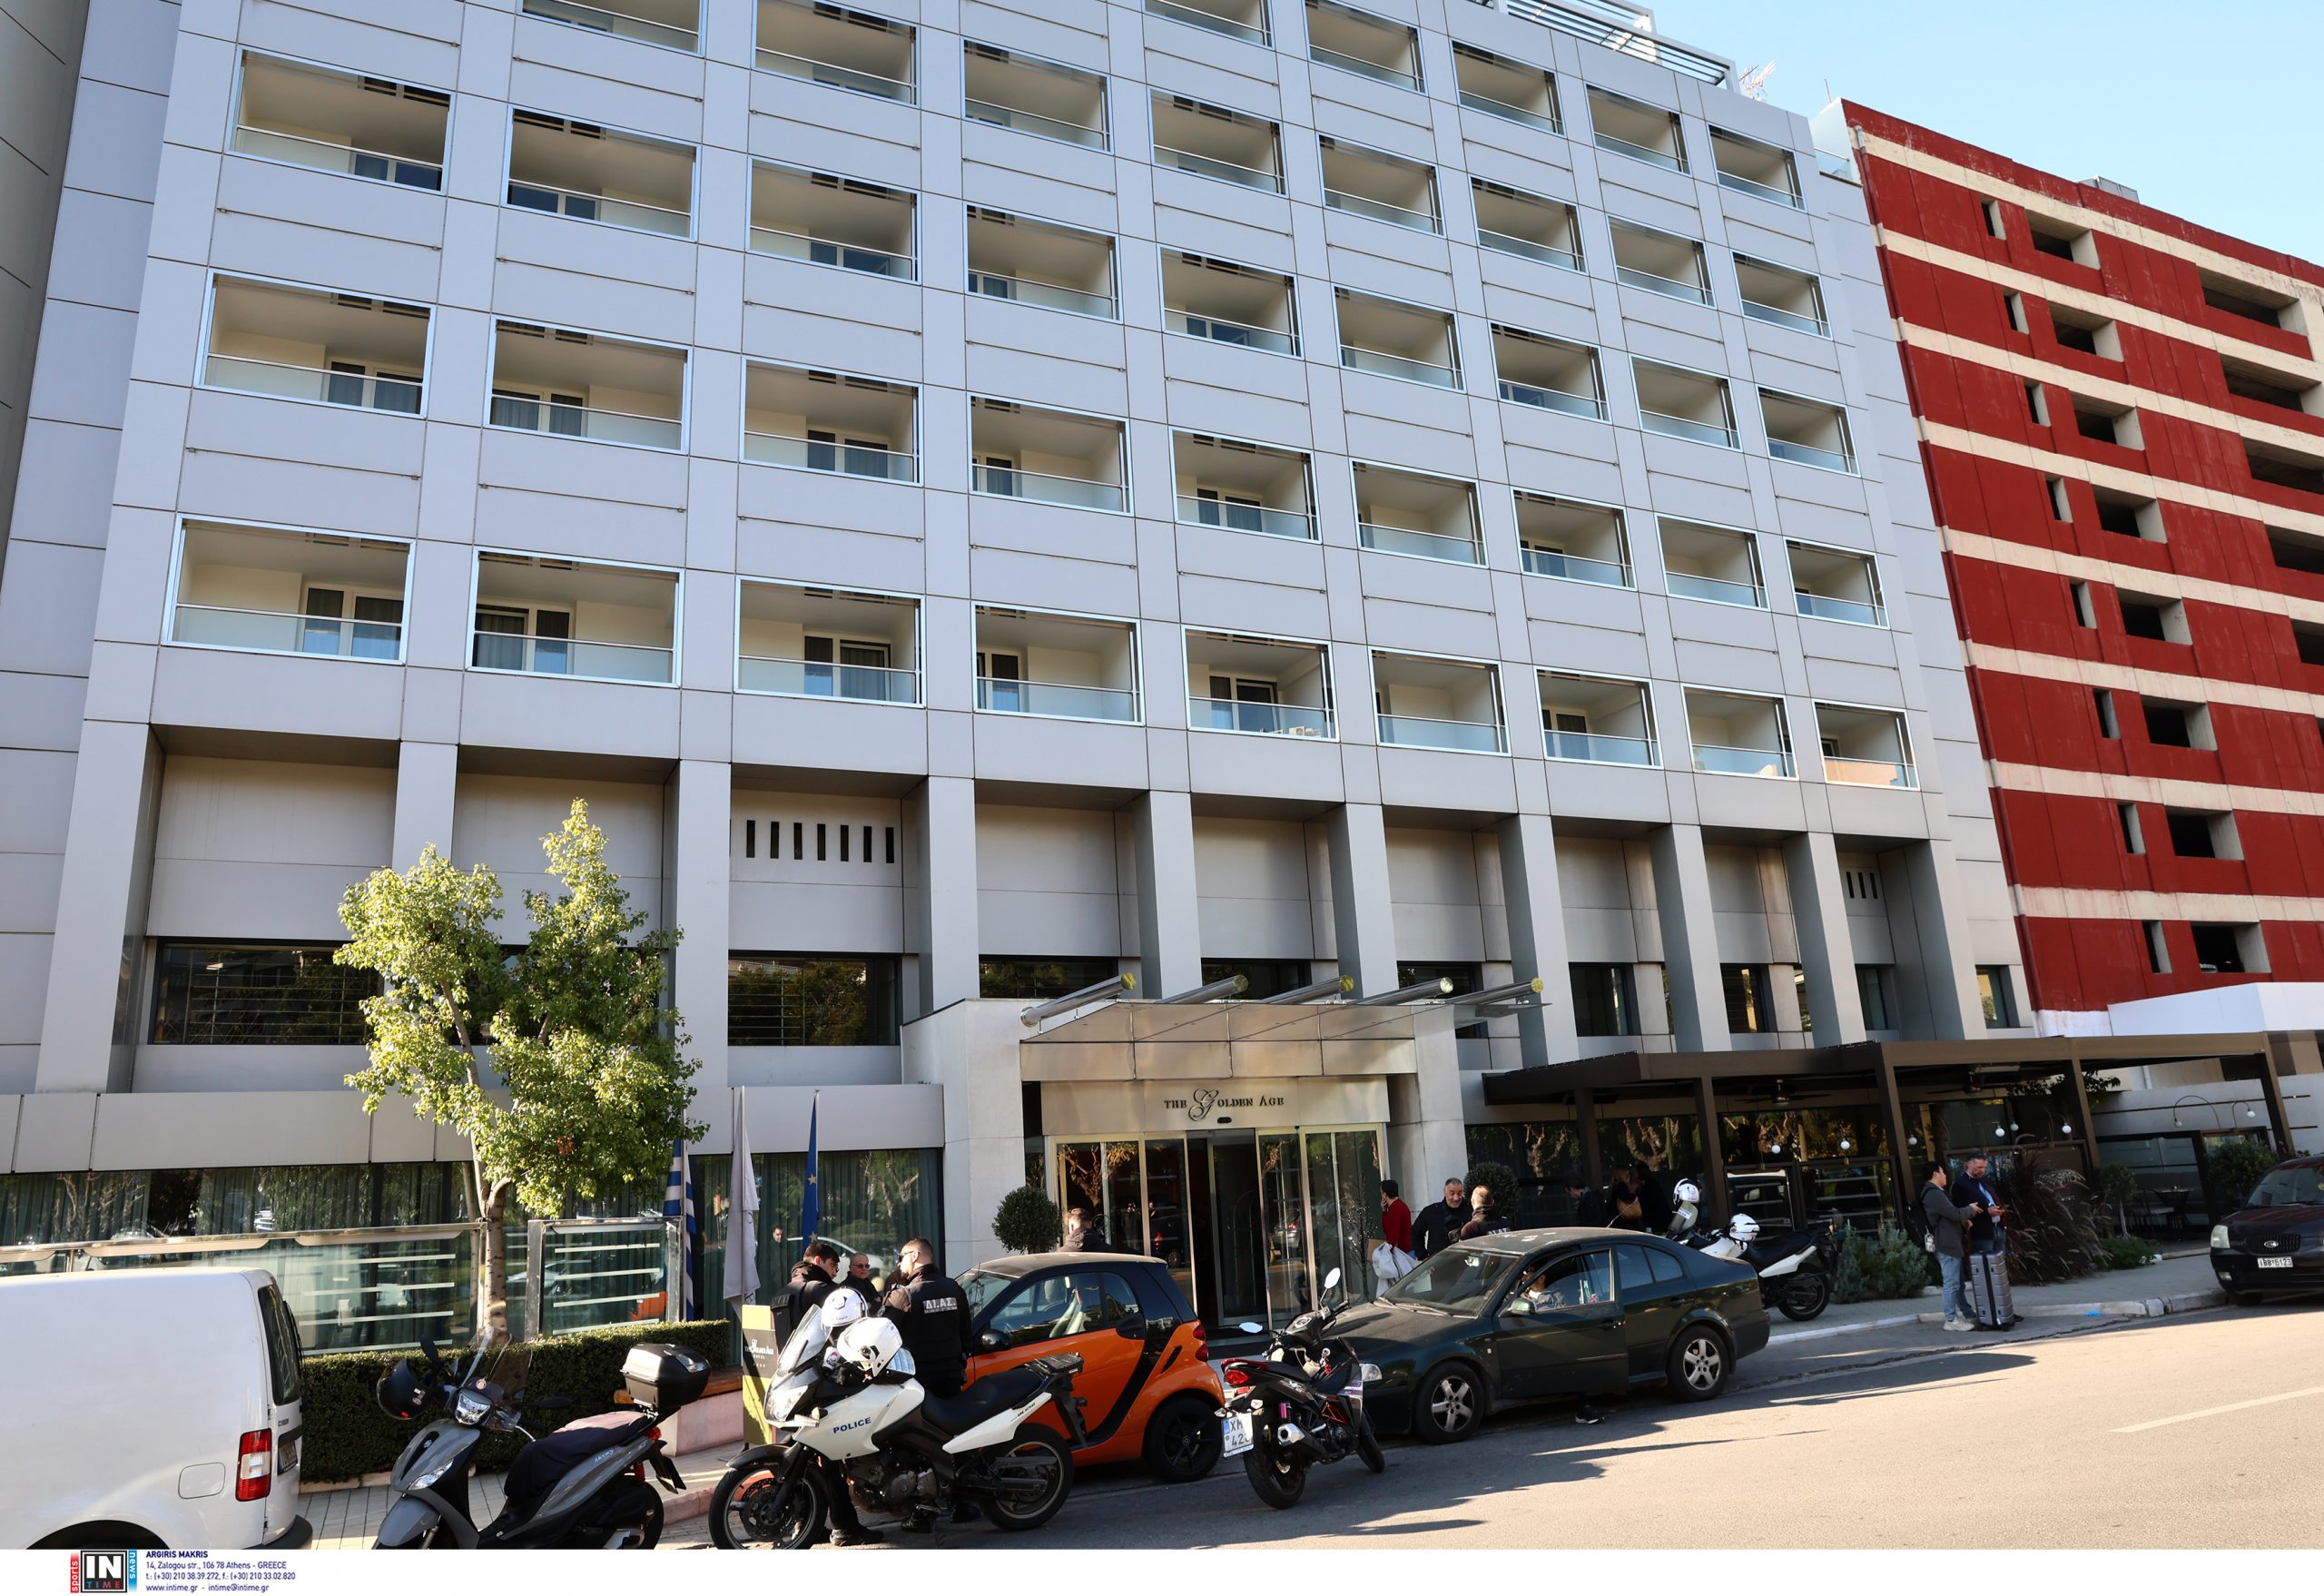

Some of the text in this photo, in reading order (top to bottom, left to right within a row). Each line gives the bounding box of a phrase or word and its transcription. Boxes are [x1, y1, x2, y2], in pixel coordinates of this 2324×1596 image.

[1164, 1089, 1285, 1121] THE GOLDEN AGE
[833, 1417, 872, 1433] POLICE
